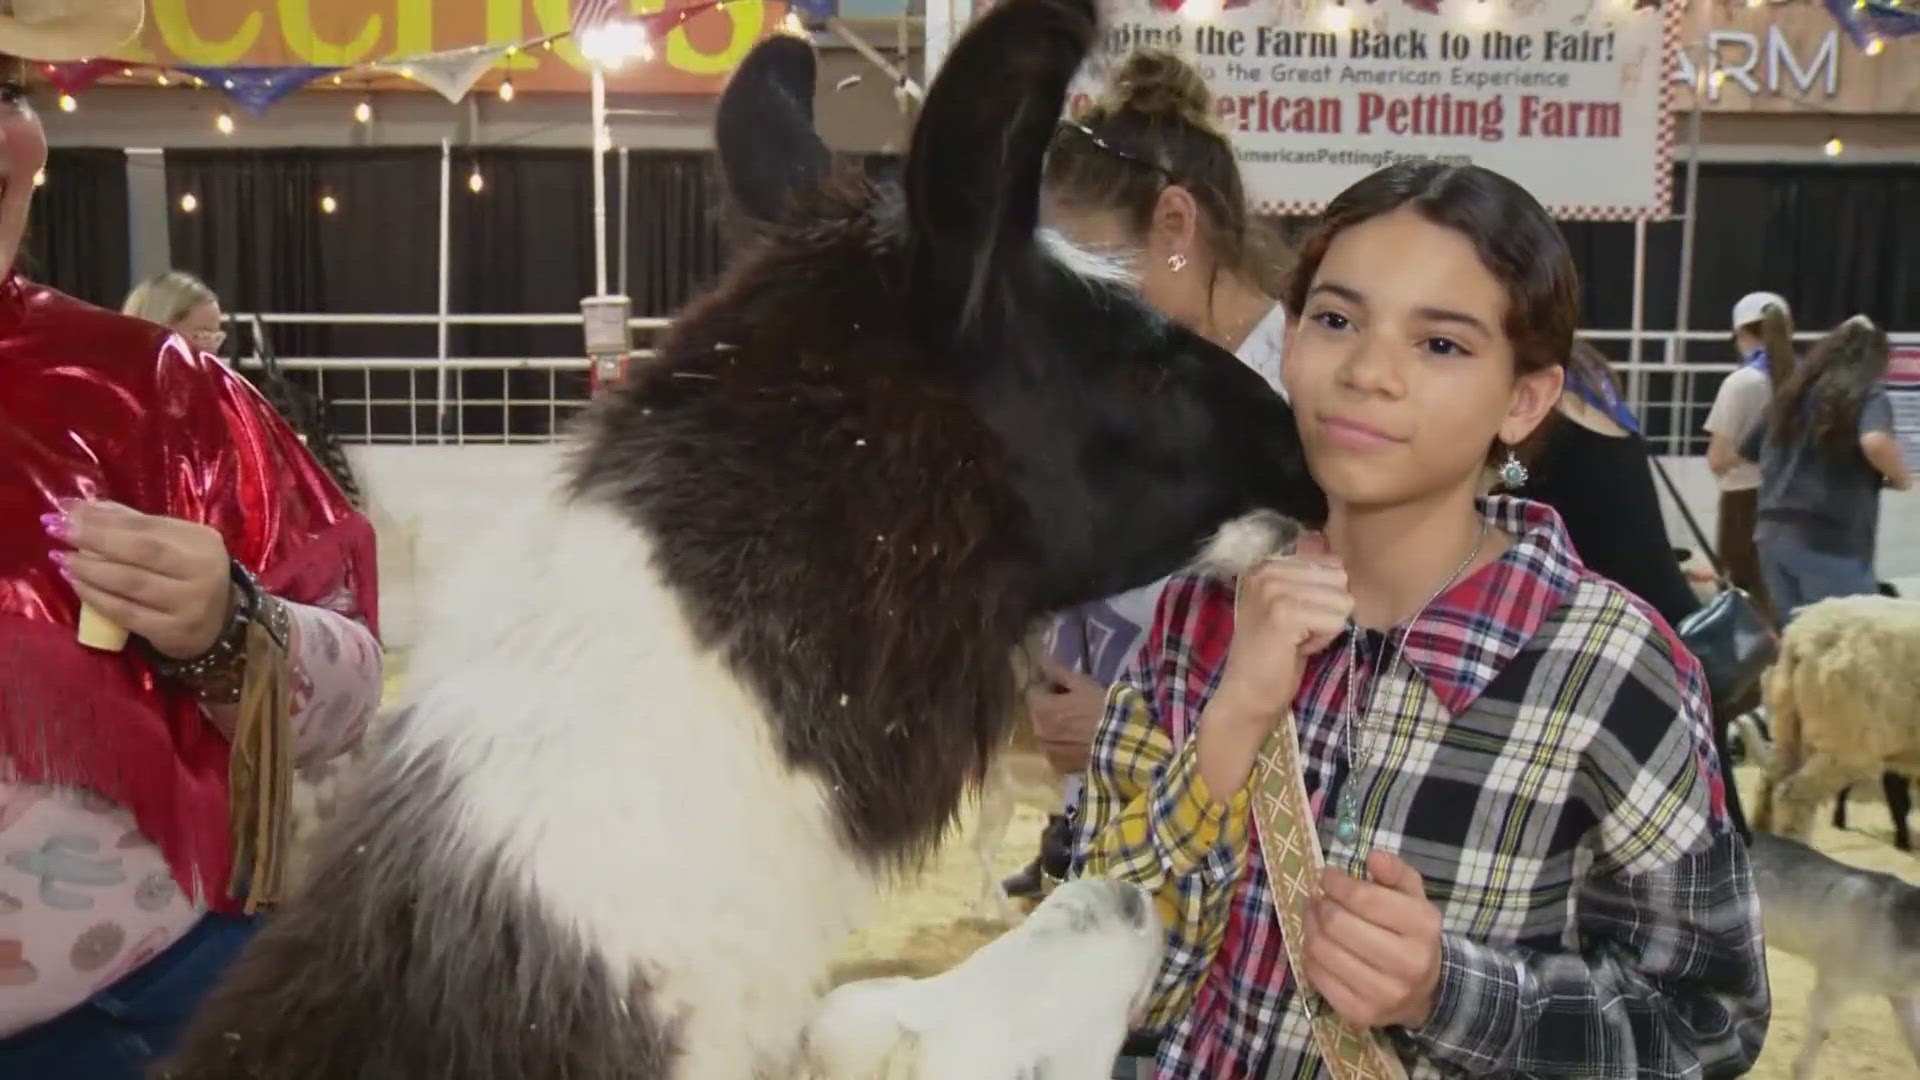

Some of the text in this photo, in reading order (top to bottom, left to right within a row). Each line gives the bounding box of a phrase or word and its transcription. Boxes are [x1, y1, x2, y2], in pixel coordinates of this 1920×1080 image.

[1196, 25, 1245, 56] the
[1256, 26, 1338, 58] Farm
[1350, 28, 1428, 60] Back
[1440, 30, 1470, 61] to
[1483, 31, 1532, 61] the
[1543, 31, 1616, 62] Fair!
[1226, 62, 1261, 82] the
[1271, 63, 1331, 84] Great
[1340, 65, 1442, 86] American
[1450, 66, 1570, 90] Experience
[1216, 90, 1622, 142] erican Petting Farm
